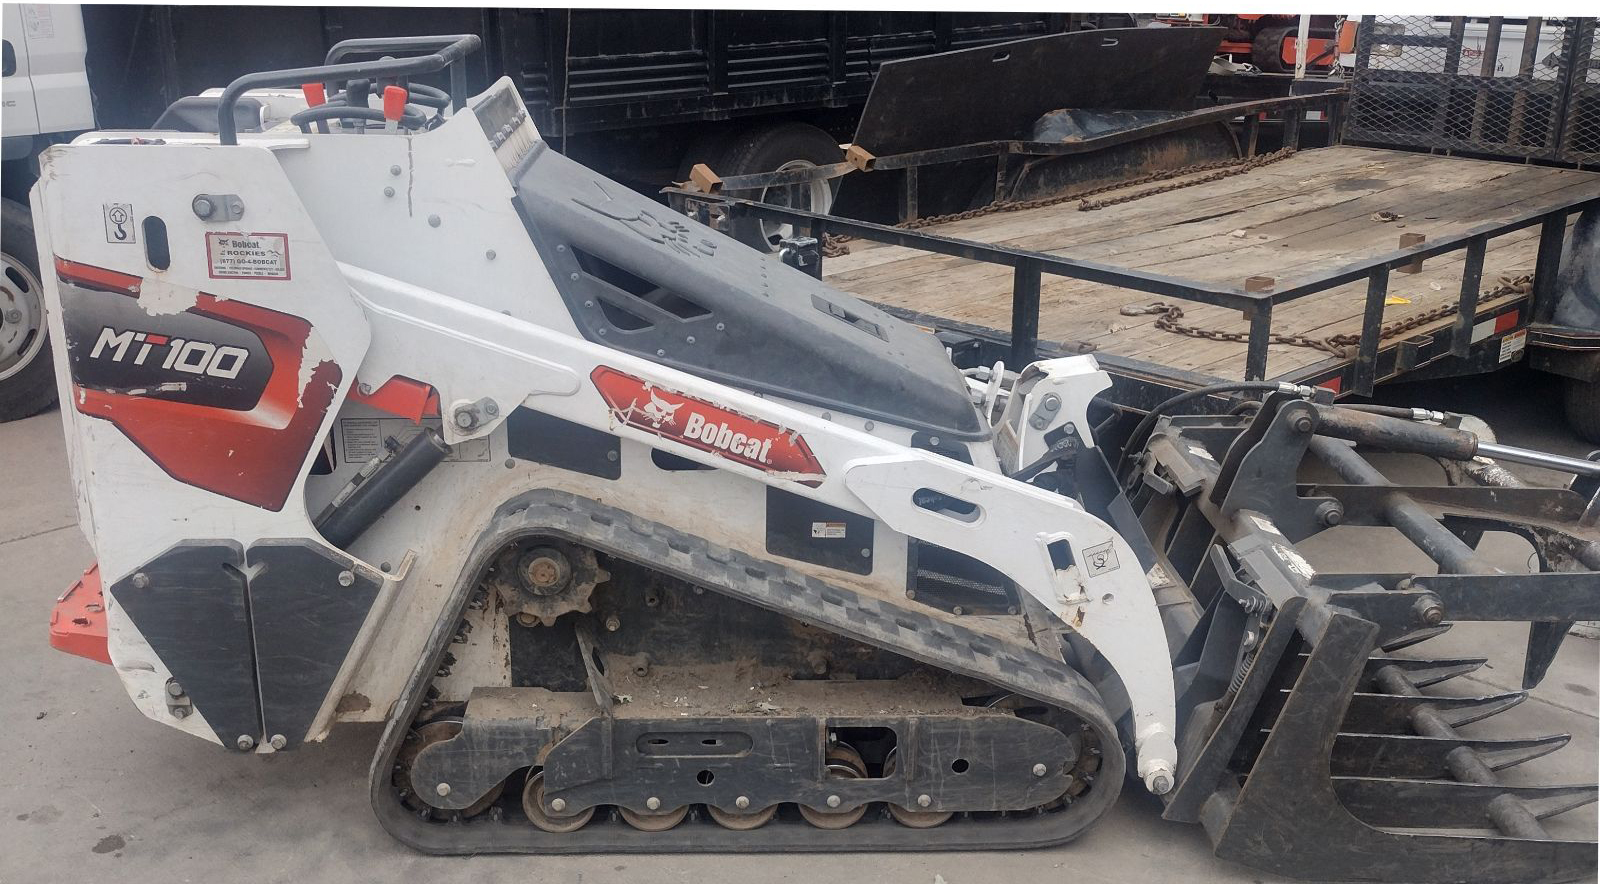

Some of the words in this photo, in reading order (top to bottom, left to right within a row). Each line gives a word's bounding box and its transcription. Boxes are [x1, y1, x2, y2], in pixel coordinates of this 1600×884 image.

[232, 240, 260, 249] Bobcat
[89, 327, 249, 380] MT100
[683, 411, 772, 464] Bobcat
